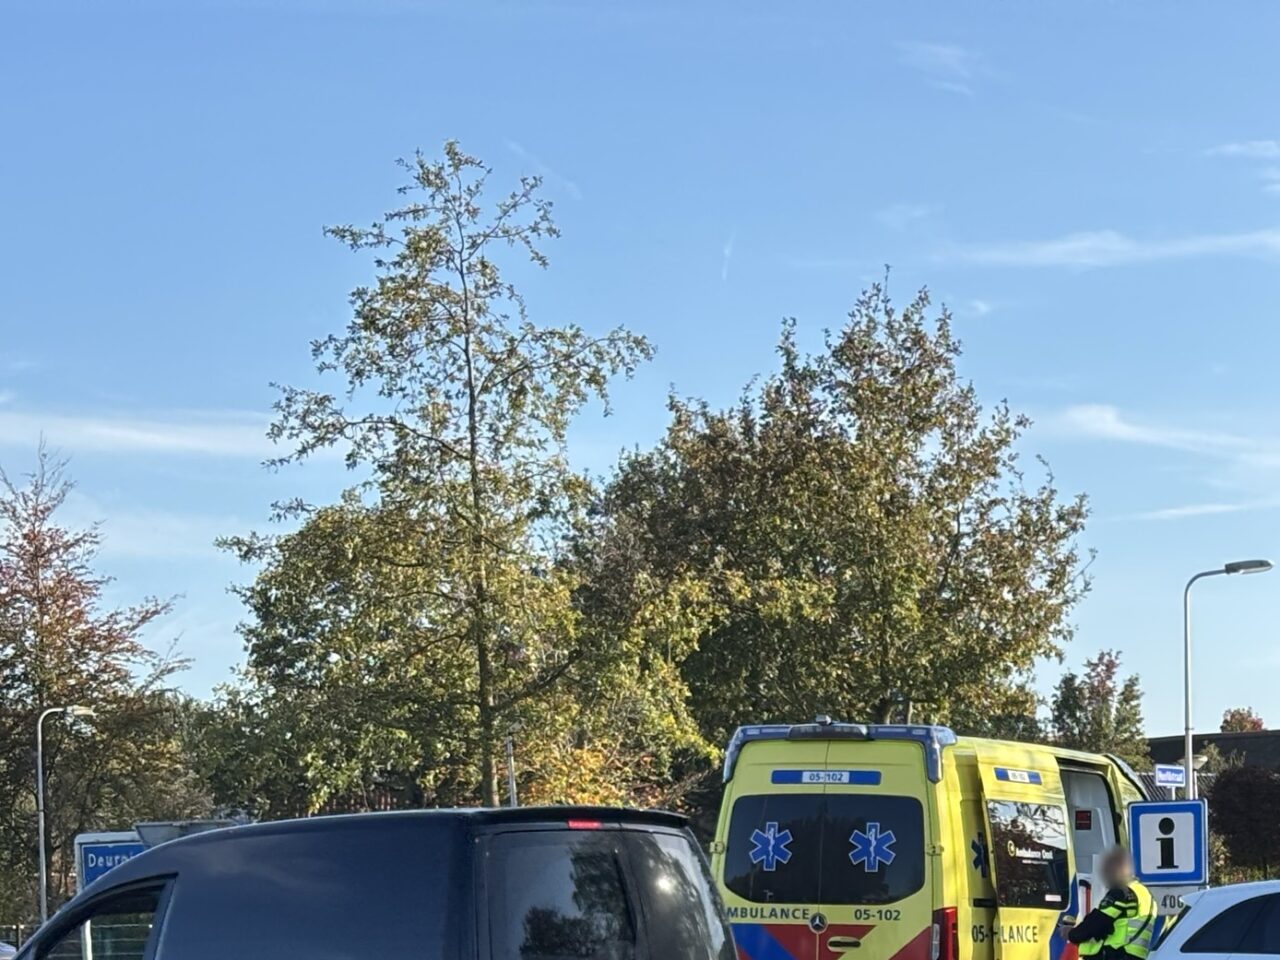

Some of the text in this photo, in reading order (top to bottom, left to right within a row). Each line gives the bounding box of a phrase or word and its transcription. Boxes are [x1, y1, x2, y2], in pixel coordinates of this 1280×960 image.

[808, 773, 844, 782] 05-102
[726, 907, 901, 921] MBULANCE 05-102
